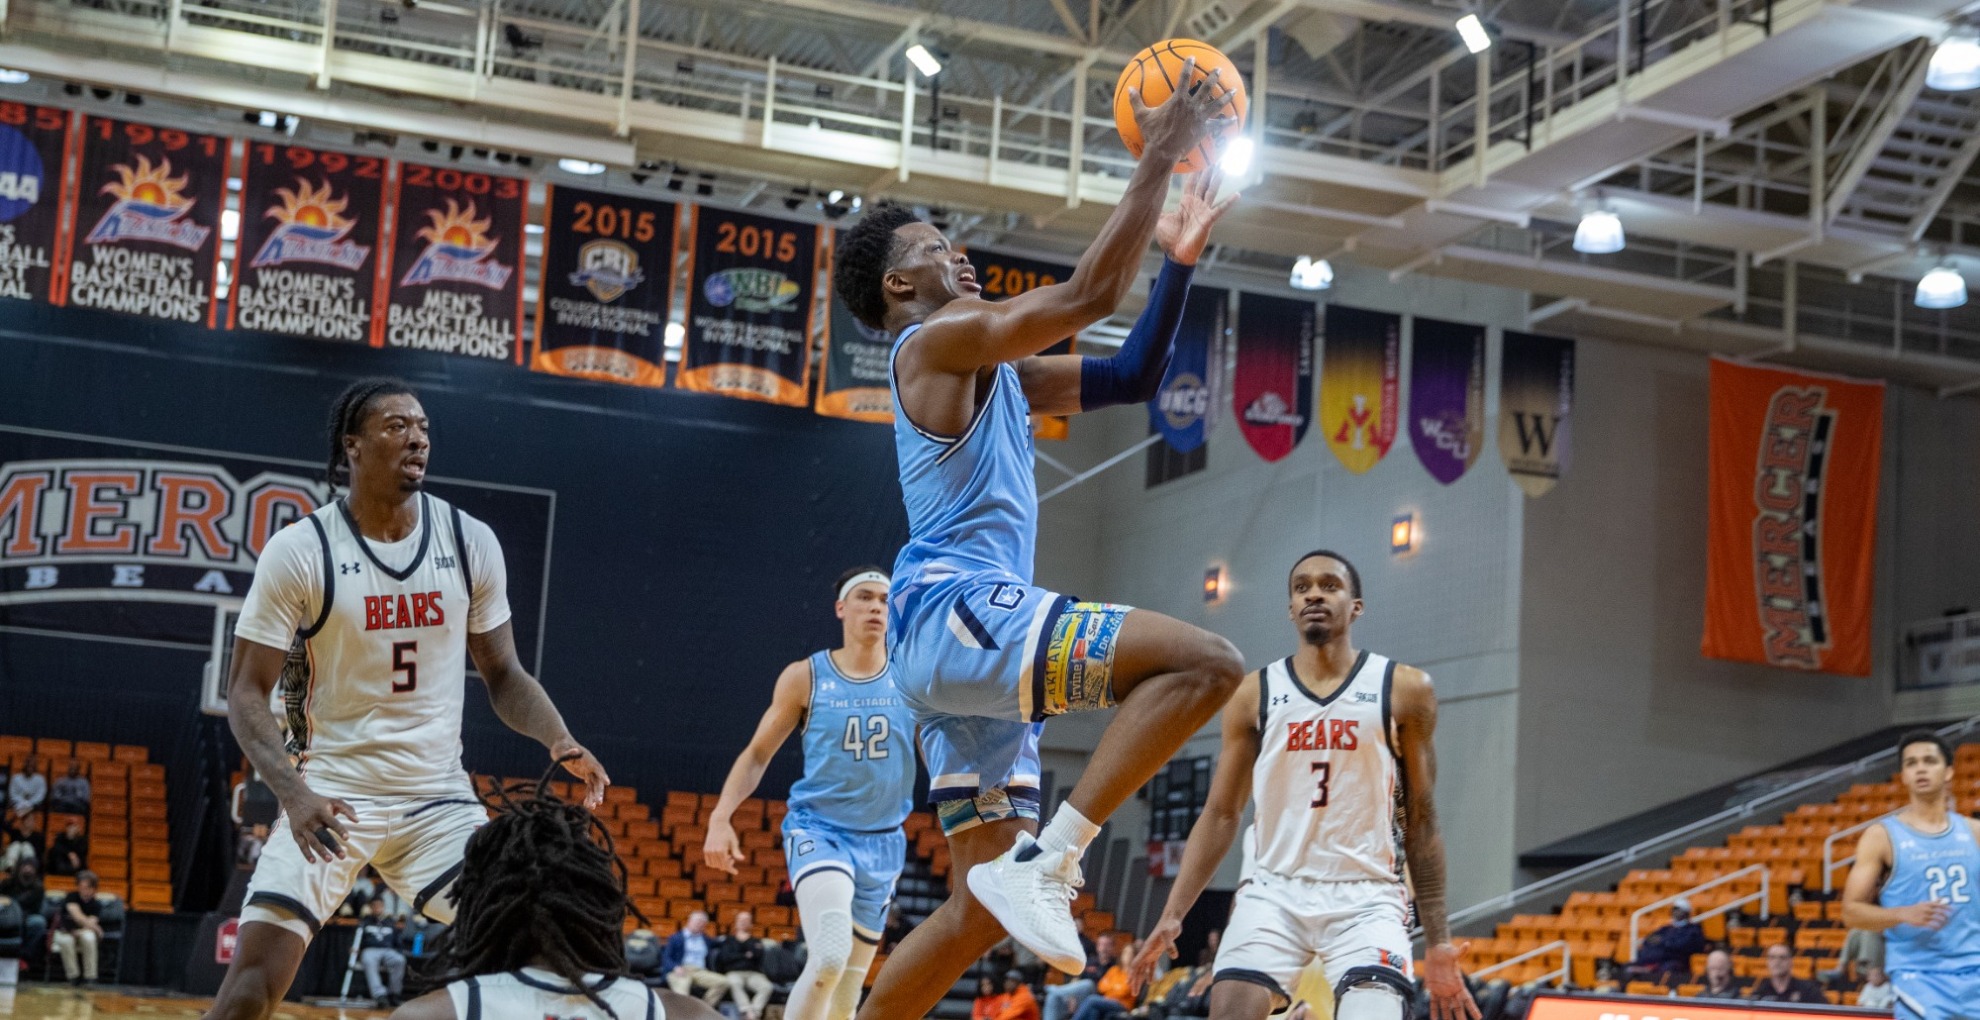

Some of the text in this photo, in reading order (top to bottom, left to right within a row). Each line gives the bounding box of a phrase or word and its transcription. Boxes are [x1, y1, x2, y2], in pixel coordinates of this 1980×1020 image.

[94, 118, 217, 157] 1991
[258, 145, 381, 179] 1992
[406, 166, 519, 198] 2003
[572, 202, 656, 242] 2015
[716, 222, 798, 262] 2015
[71, 260, 209, 303] BASKETBALL
[92, 244, 194, 281] WOMEN'S
[71, 283, 202, 323] CHAMPIONS
[258, 268, 355, 300] WOMEN'S
[238, 285, 370, 322] BASKETBALL
[388, 303, 515, 341] BASKETBALL
[422, 290, 483, 317] MEN'S
[238, 307, 363, 341] CHAMPIONS
[388, 327, 509, 361] CHAMPIONS
[1419, 417, 1472, 460] WCU
[1512, 410, 1559, 458] W
[1755, 385, 1828, 668] MERCER
[364, 591, 445, 631] BEARS
[987, 582, 1026, 612] C
[392, 641, 418, 693] 5
[1070, 664, 1083, 701] Irvine
[828, 697, 898, 708] THE CITADEL
[843, 714, 890, 761] 42
[1286, 719, 1359, 752] BEARS
[1311, 762, 1330, 808] 3
[1925, 864, 1971, 905] 22
